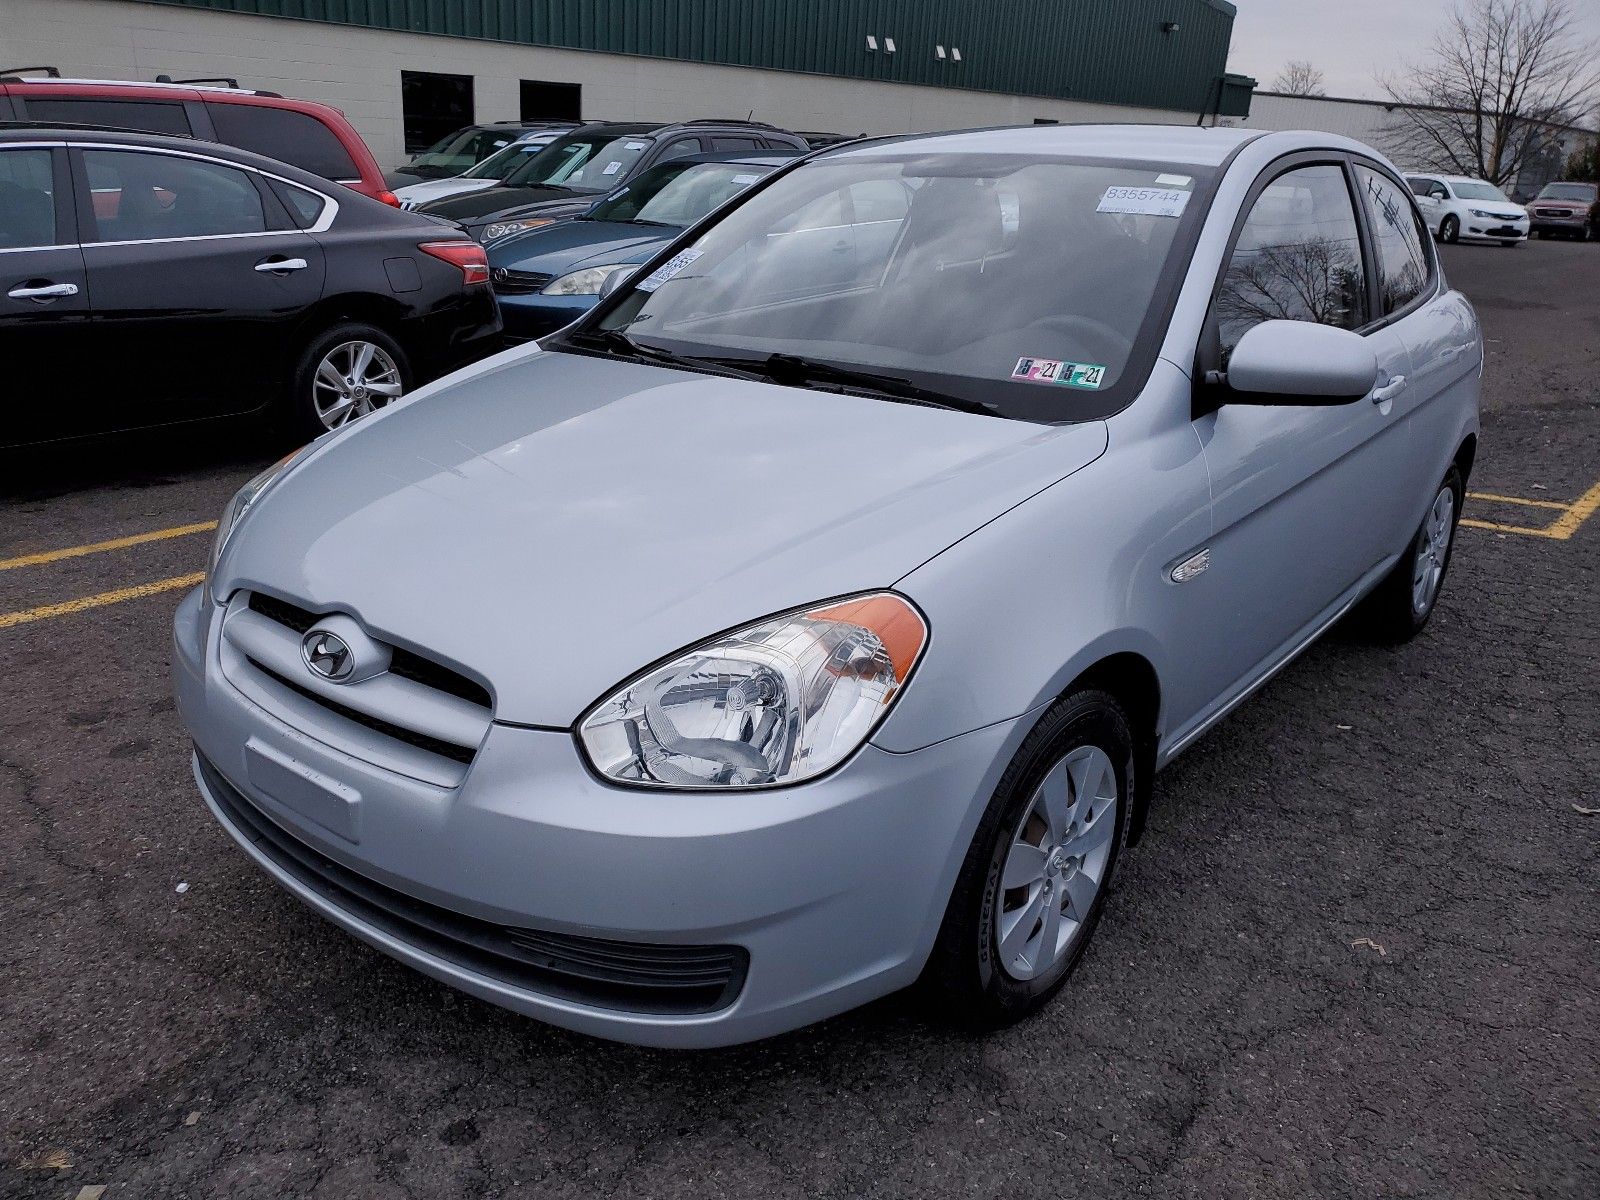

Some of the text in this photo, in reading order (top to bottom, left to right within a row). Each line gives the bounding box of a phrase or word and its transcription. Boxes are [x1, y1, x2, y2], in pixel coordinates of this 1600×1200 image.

[1106, 188, 1179, 203] 8355744
[1042, 362, 1057, 378] 21
[1085, 367, 1101, 383] 21
